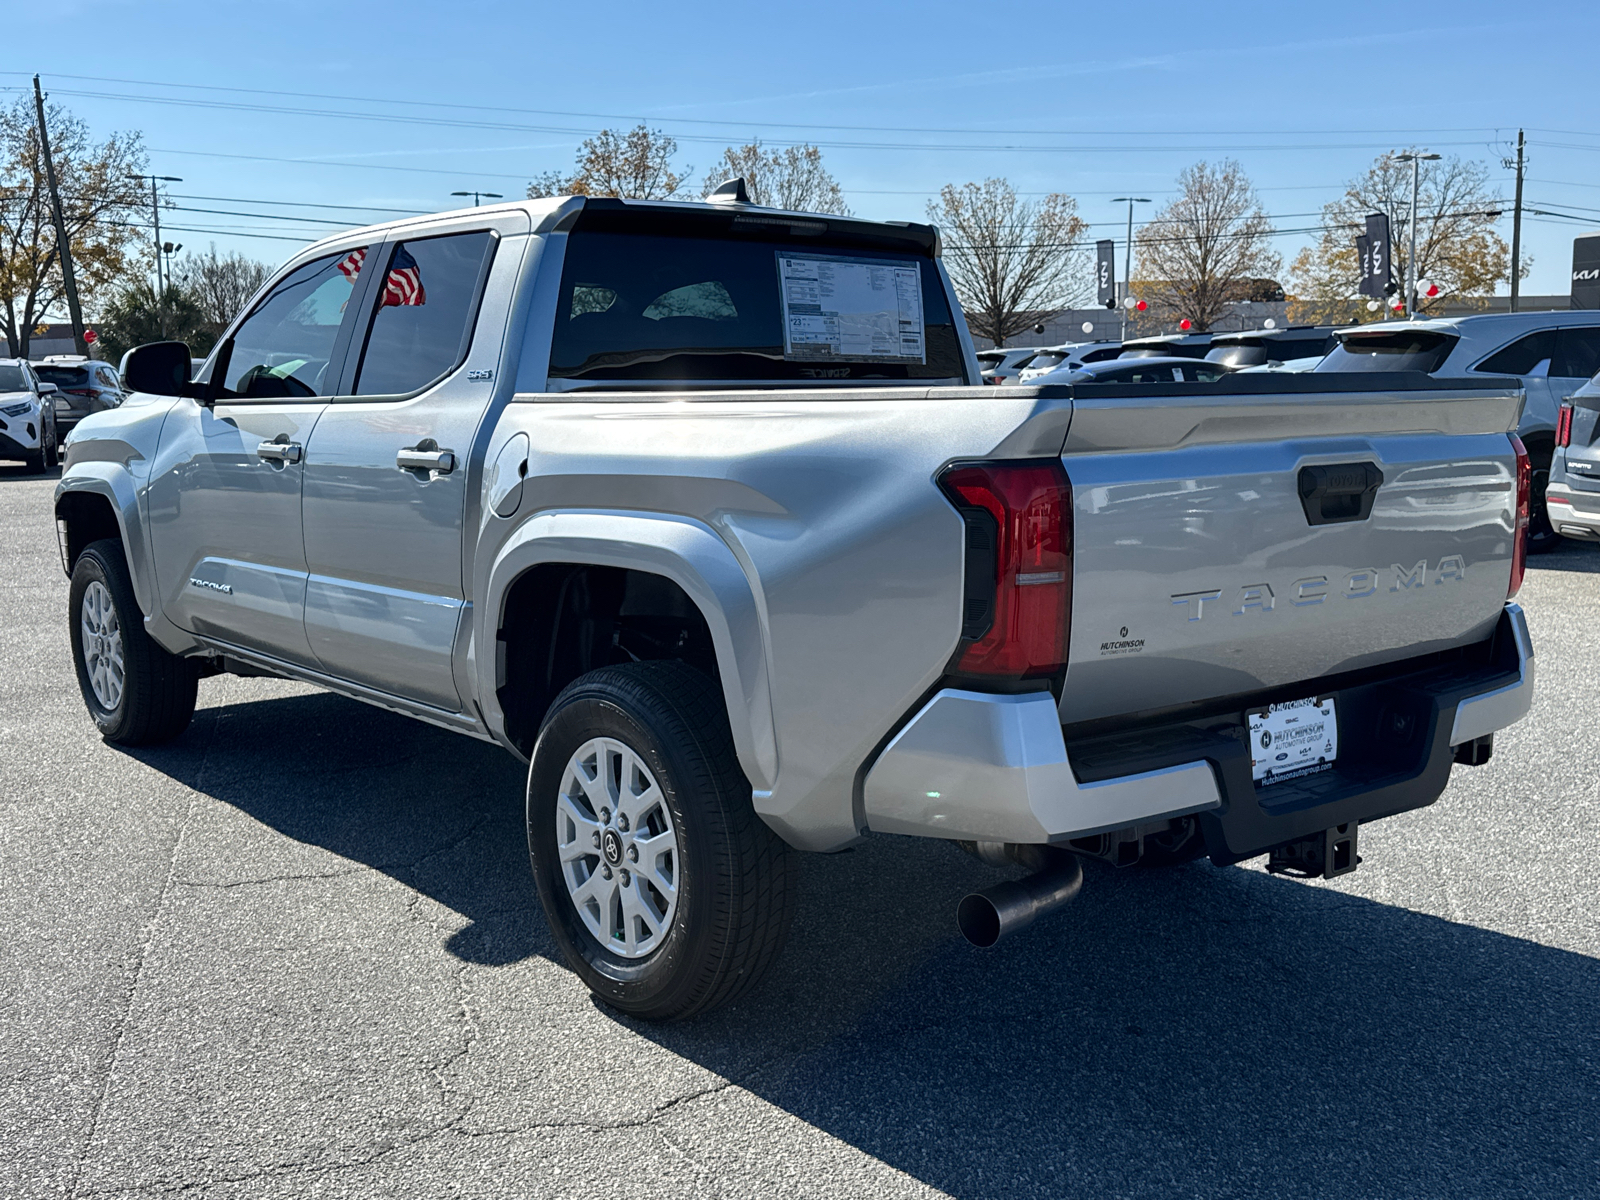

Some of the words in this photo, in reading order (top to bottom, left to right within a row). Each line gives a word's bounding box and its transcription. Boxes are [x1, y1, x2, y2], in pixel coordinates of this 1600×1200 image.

[1572, 268, 1600, 281] KIA
[1329, 474, 1365, 487] TOYOTA
[190, 577, 233, 595] TACOMA
[1170, 554, 1466, 623] TACOMA
[1100, 639, 1145, 650] HUTCHINSON
[1100, 648, 1127, 656] AUTOMOTIVE
[1277, 696, 1318, 712] HUTCHINSON
[1273, 721, 1325, 743] HUTCHINSON
[1274, 738, 1306, 751] AUTOMOTIVE
[1306, 734, 1323, 743] GROUP
[1262, 763, 1332, 787] Hutchinsonautogroup.com
